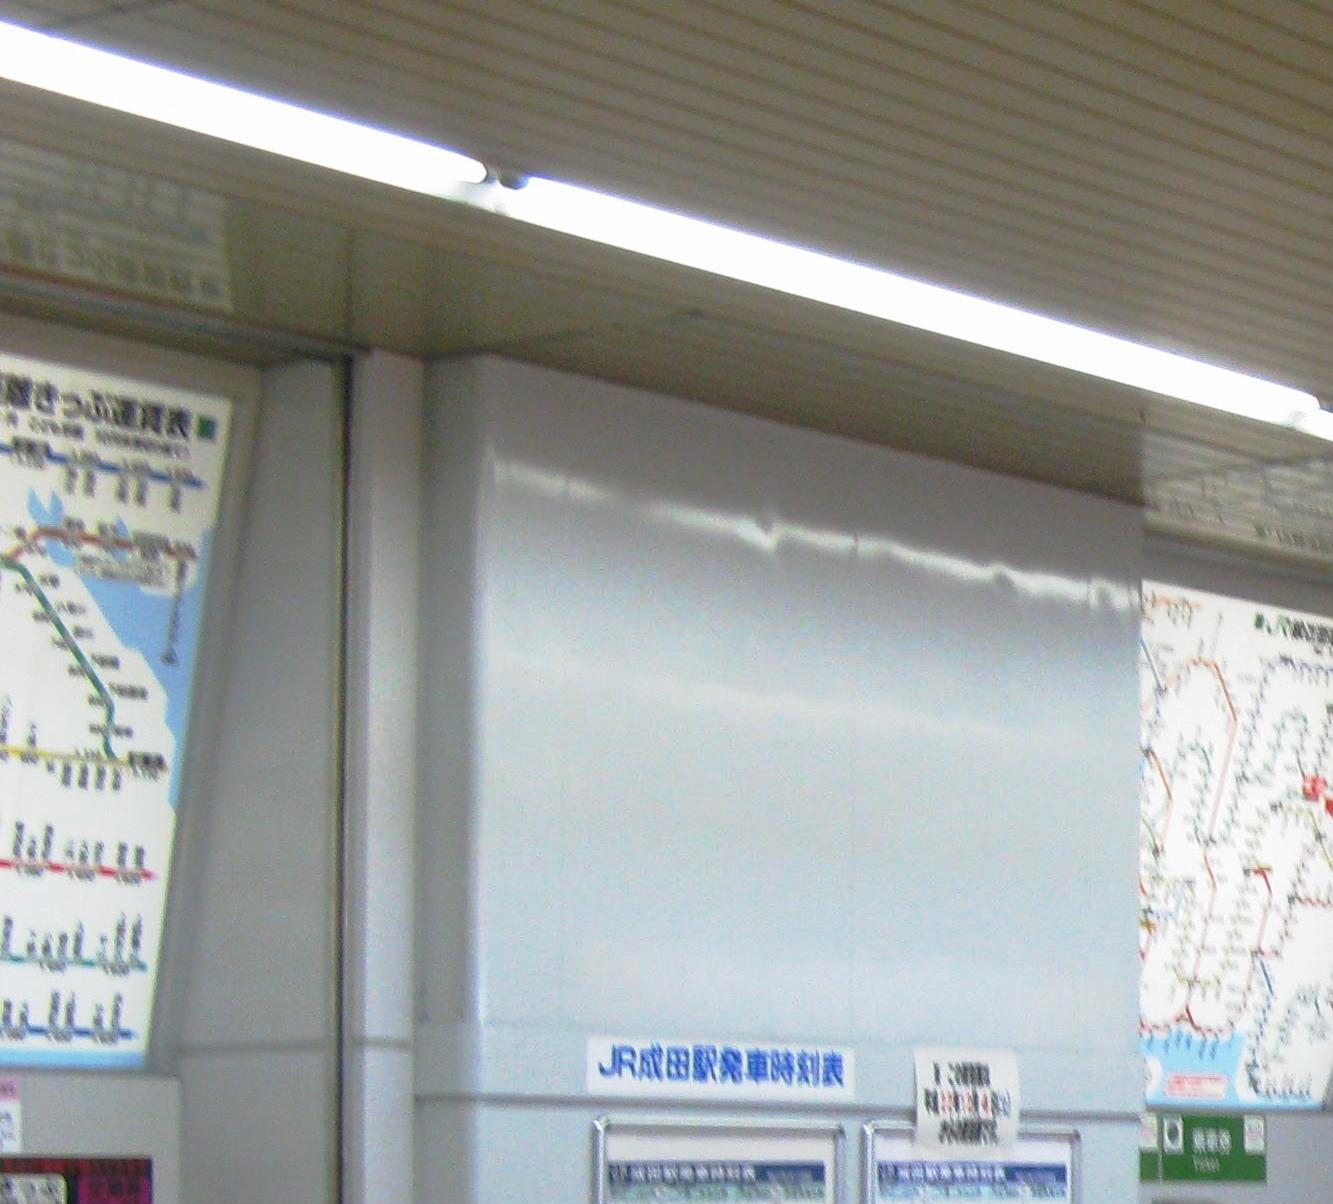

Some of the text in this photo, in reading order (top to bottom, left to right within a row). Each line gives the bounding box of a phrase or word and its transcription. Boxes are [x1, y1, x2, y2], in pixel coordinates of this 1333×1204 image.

[598, 1041, 845, 1088] JR成田駅発車時刻表
